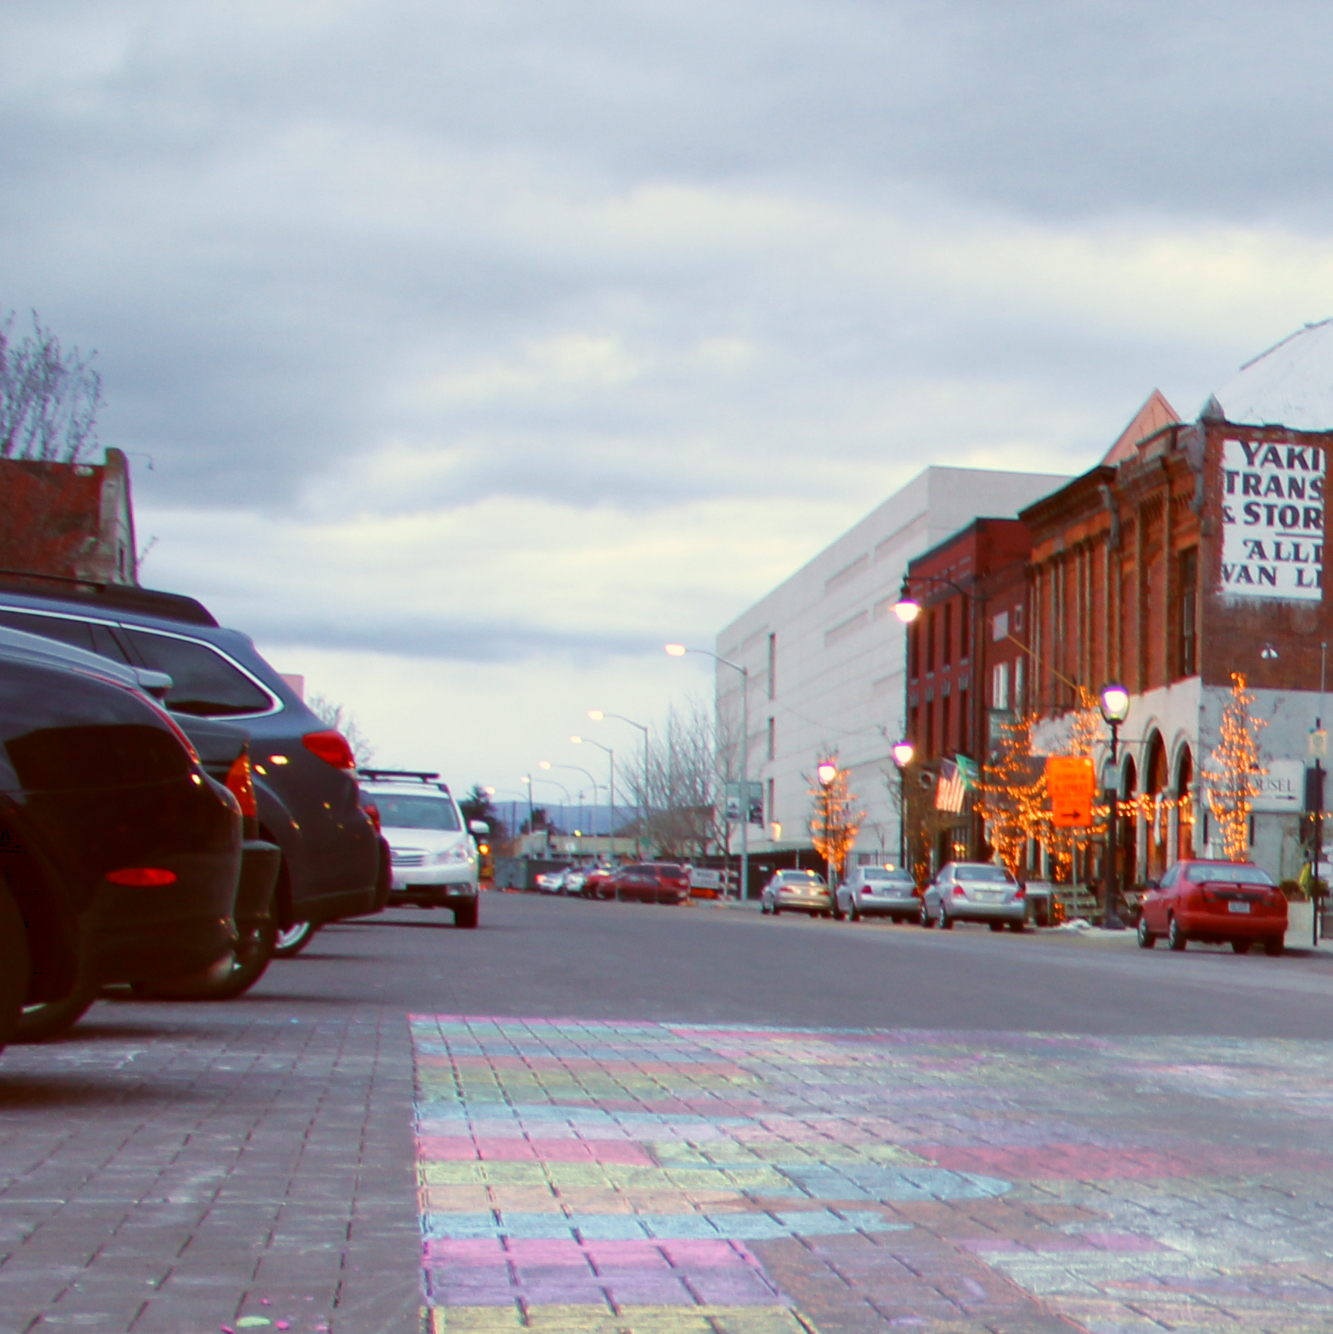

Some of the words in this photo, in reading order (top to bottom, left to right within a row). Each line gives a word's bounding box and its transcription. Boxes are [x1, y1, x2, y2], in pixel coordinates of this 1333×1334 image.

[1239, 439, 1321, 471] YAKI
[1225, 470, 1324, 502] TRANS
[1222, 505, 1237, 525] &
[1243, 501, 1323, 532] STOR
[1222, 564, 1278, 587] VAN
